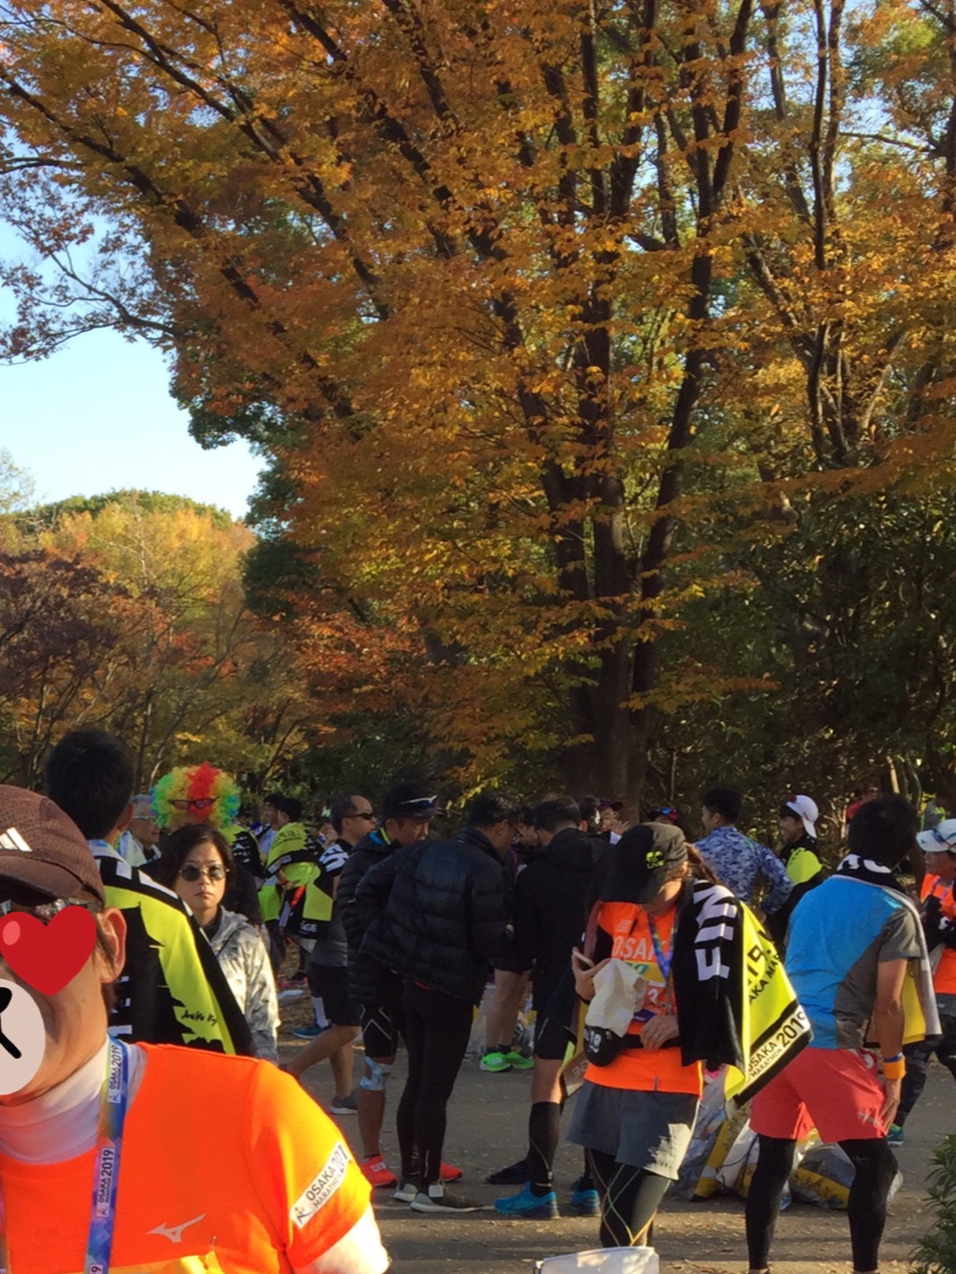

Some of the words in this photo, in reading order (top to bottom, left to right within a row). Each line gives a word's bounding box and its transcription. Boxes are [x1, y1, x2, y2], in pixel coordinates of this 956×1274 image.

[102, 1149, 114, 1177] 2019
[98, 1176, 108, 1203] OSAKA
[305, 1165, 336, 1201] OSAKA
